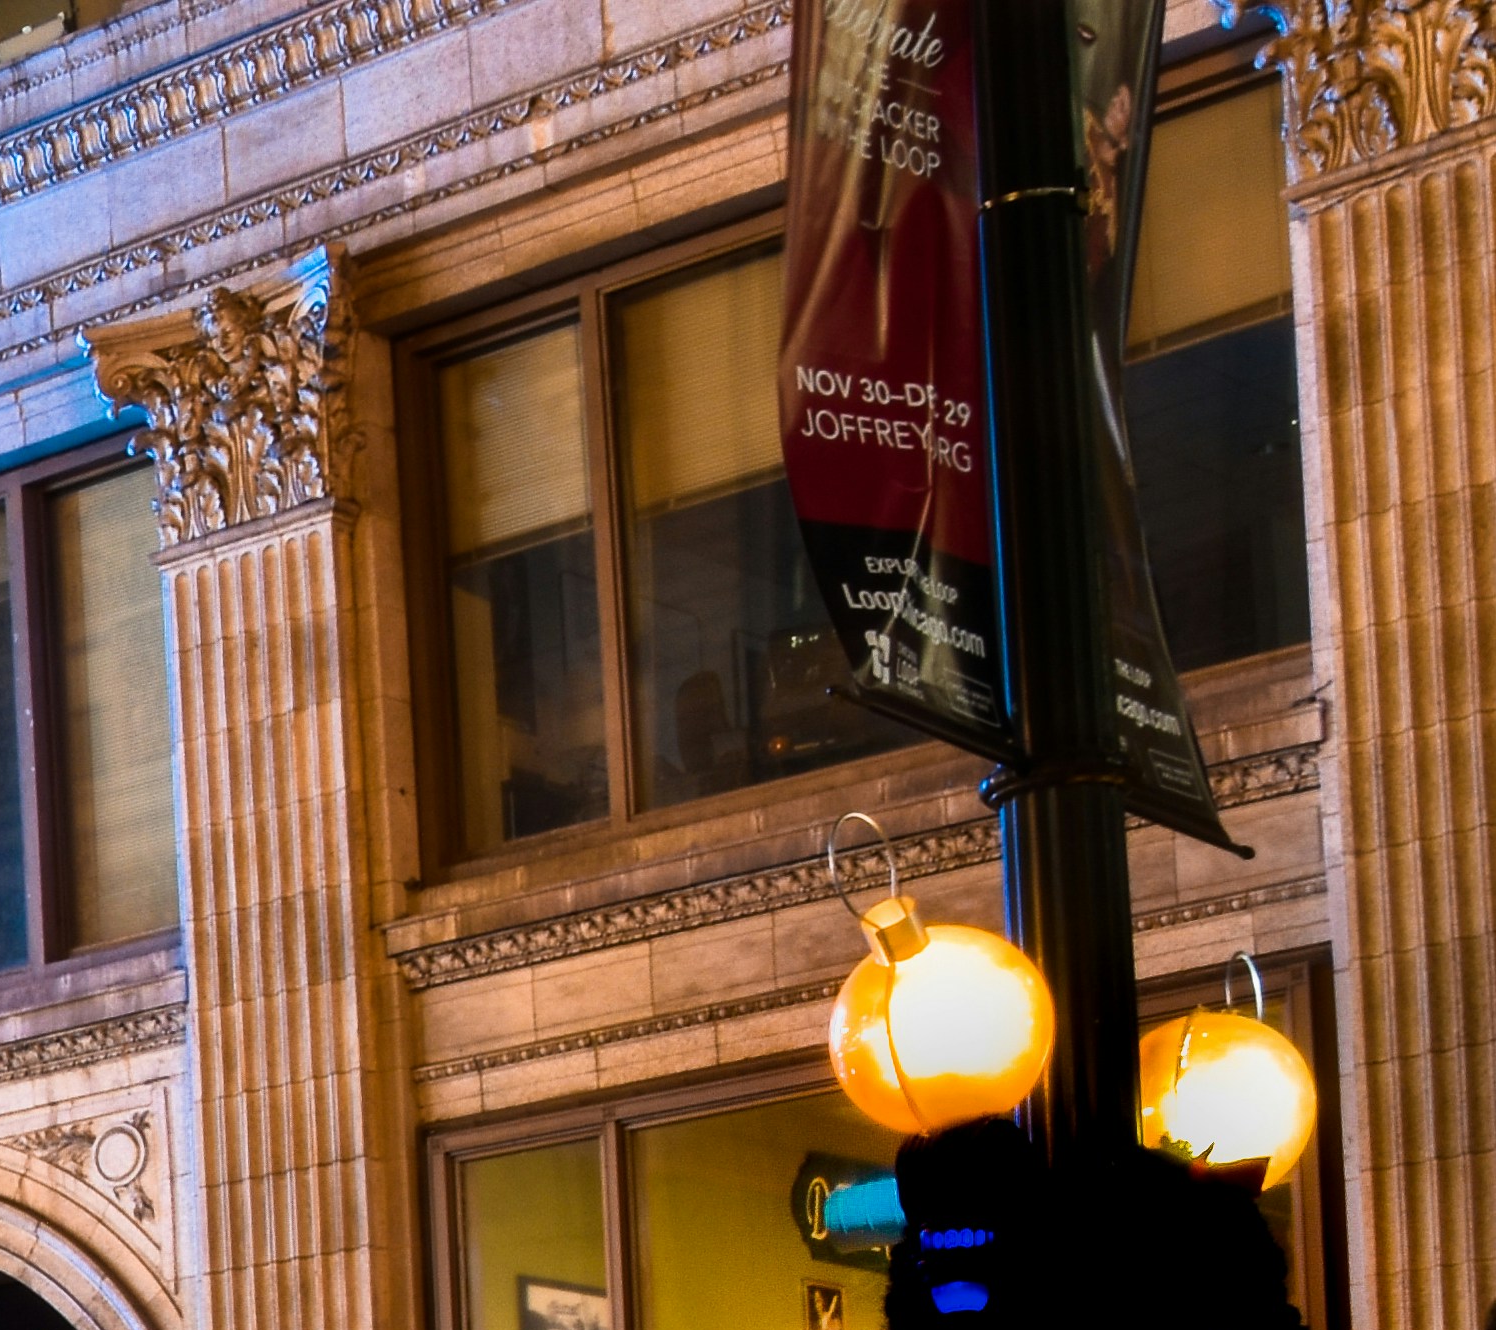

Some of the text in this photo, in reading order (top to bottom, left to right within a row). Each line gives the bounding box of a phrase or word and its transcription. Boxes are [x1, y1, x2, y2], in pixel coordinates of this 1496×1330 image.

[880, 136, 941, 177] LOOP
[796, 366, 853, 399] NOV
[944, 399, 971, 427] 29
